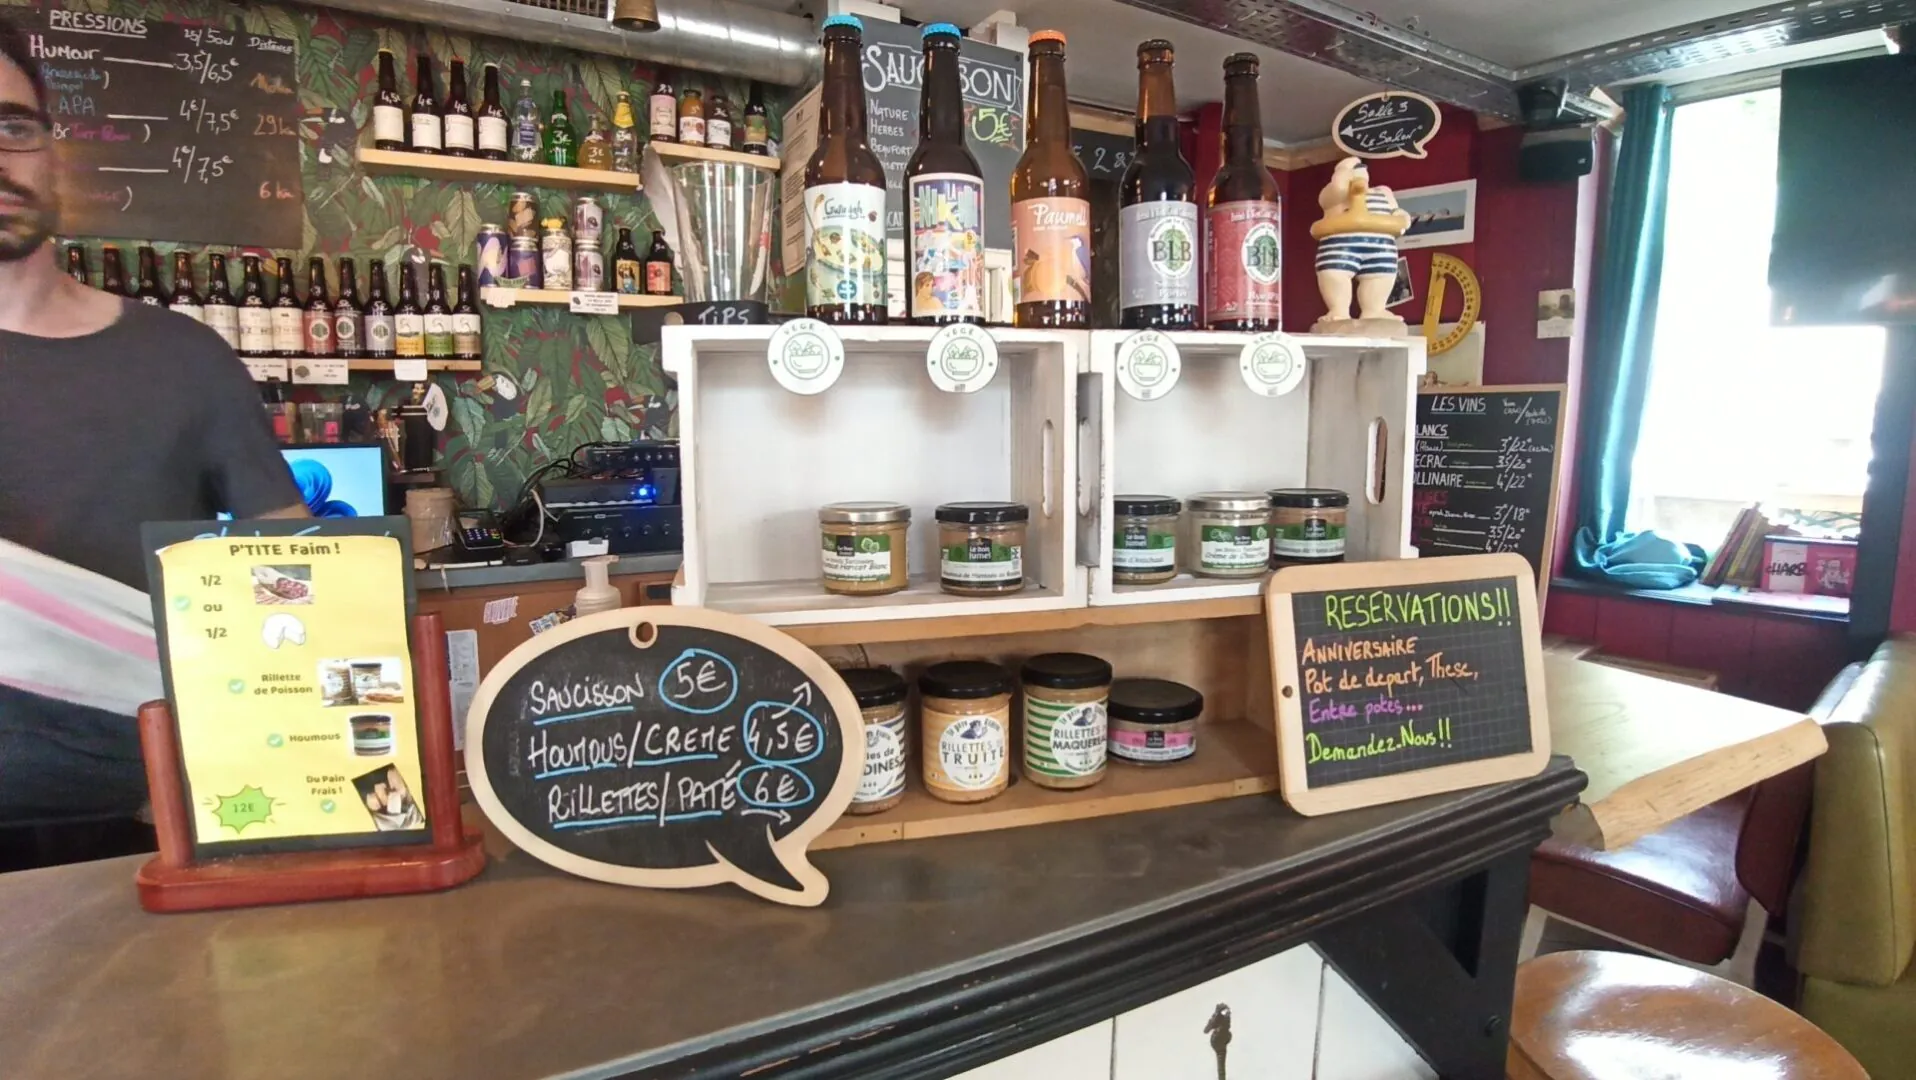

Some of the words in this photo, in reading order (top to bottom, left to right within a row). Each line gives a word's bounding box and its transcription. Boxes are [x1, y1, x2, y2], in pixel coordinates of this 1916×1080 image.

[50, 10, 147, 34] PRESSIONS
[29, 34, 100, 60] Humour
[863, 45, 1013, 101] SAUCSON
[870, 98, 909, 120] NATURE
[870, 118, 904, 137] HERBES
[972, 107, 1012, 142] 5€
[870, 137, 912, 157] BEAUFORT
[260, 182, 271, 199] 6
[1152, 240, 1191, 261] BLB
[698, 305, 750, 325] TiPS
[1430, 395, 1455, 412] LES
[1458, 396, 1487, 413] VINS
[1415, 424, 1448, 437] LANCS
[1415, 454, 1448, 469] ECRAC
[229, 543, 283, 556] P'TITE
[290, 542, 331, 556] Faim
[200, 575, 222, 587] 1/2
[1325, 588, 1511, 631] RESERVATIONS!!
[205, 627, 228, 639] 1/2
[260, 672, 302, 683] Rillette
[673, 660, 727, 699] 5€
[1304, 668, 1332, 694] Pot
[1338, 672, 1362, 692] de
[254, 686, 268, 695] de
[270, 684, 313, 695] Poisson
[1308, 697, 1357, 724] Entre
[289, 732, 341, 742] Houmous
[745, 718, 815, 756] 4,5€
[942, 741, 993, 752] RILLETTES
[943, 745, 1004, 765] TRUITE
[863, 756, 901, 777] DINES
[306, 775, 319, 784] Du
[321, 774, 345, 784] Pain
[311, 786, 335, 796] Frais
